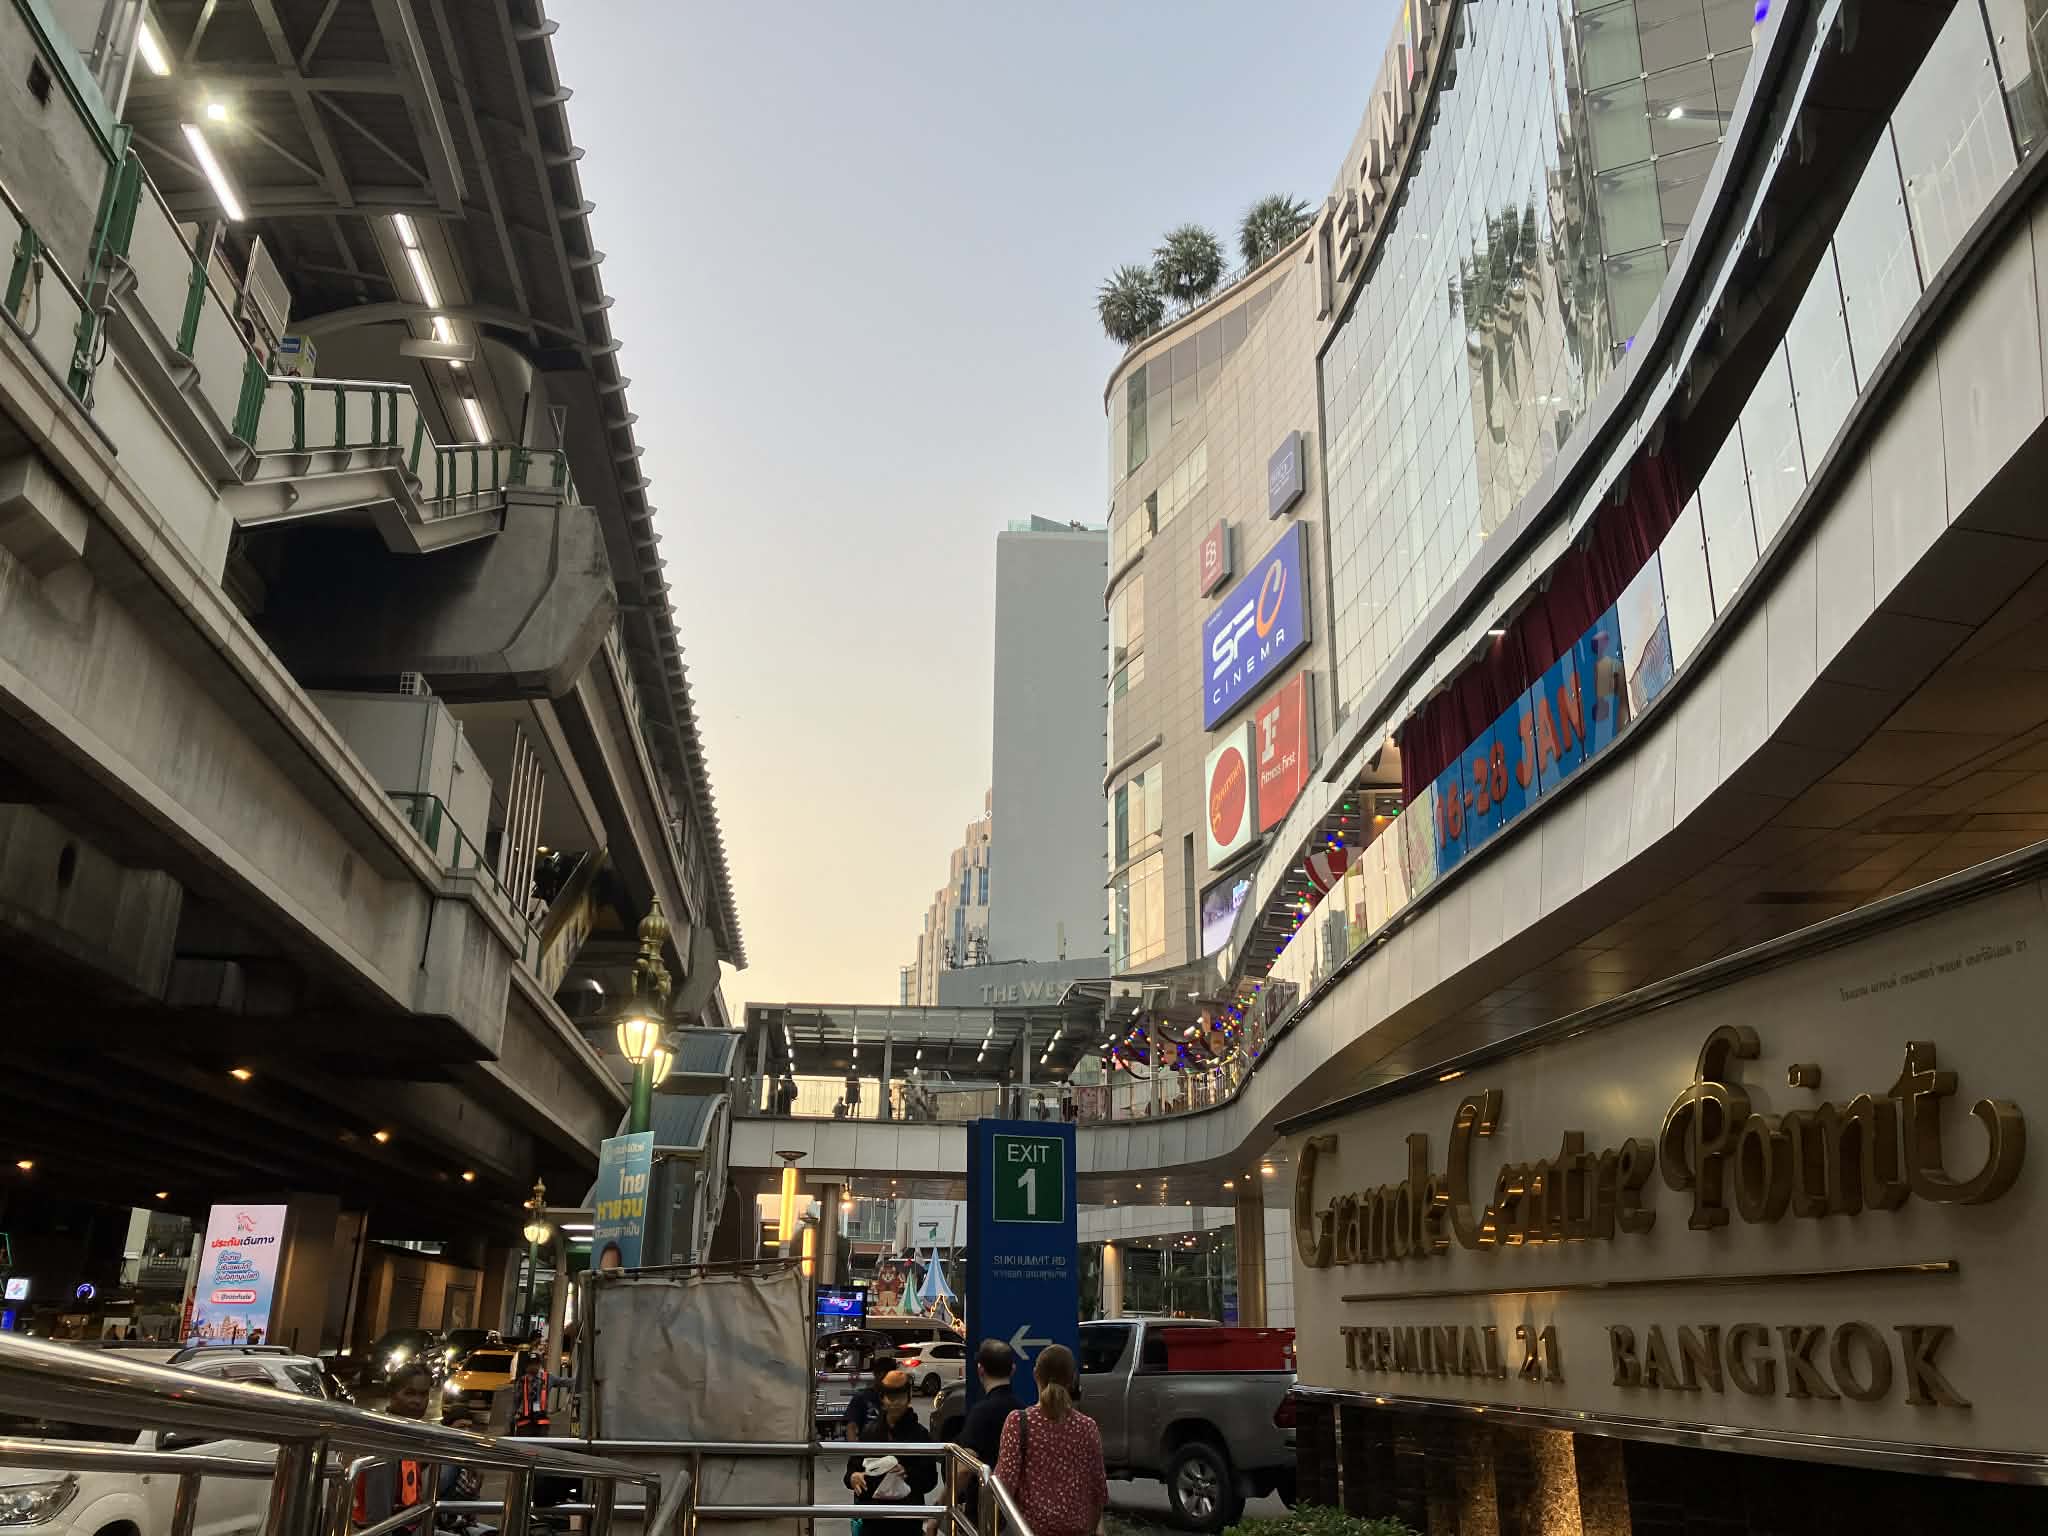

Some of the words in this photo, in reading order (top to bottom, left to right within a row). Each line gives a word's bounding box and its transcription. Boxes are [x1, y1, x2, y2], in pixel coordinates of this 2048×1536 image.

[1213, 627, 1285, 705] CINEMA
[1436, 740, 1509, 849] 16-28
[1516, 671, 1587, 790] JAN
[977, 983, 1018, 1004] THE
[1007, 1143, 1050, 1164] EXIT
[1447, 1089, 1657, 1250] Centre
[1660, 1024, 2027, 1231] Point
[1017, 1168, 1037, 1216] 1
[211, 1235, 275, 1249] ประกันเดินทาง
[992, 1255, 1049, 1266] SUKHUMVIT
[1340, 1323, 1504, 1380] TERMINAL
[1515, 1324, 1565, 1384] 21
[1604, 1319, 1973, 1409] BANGKOK
